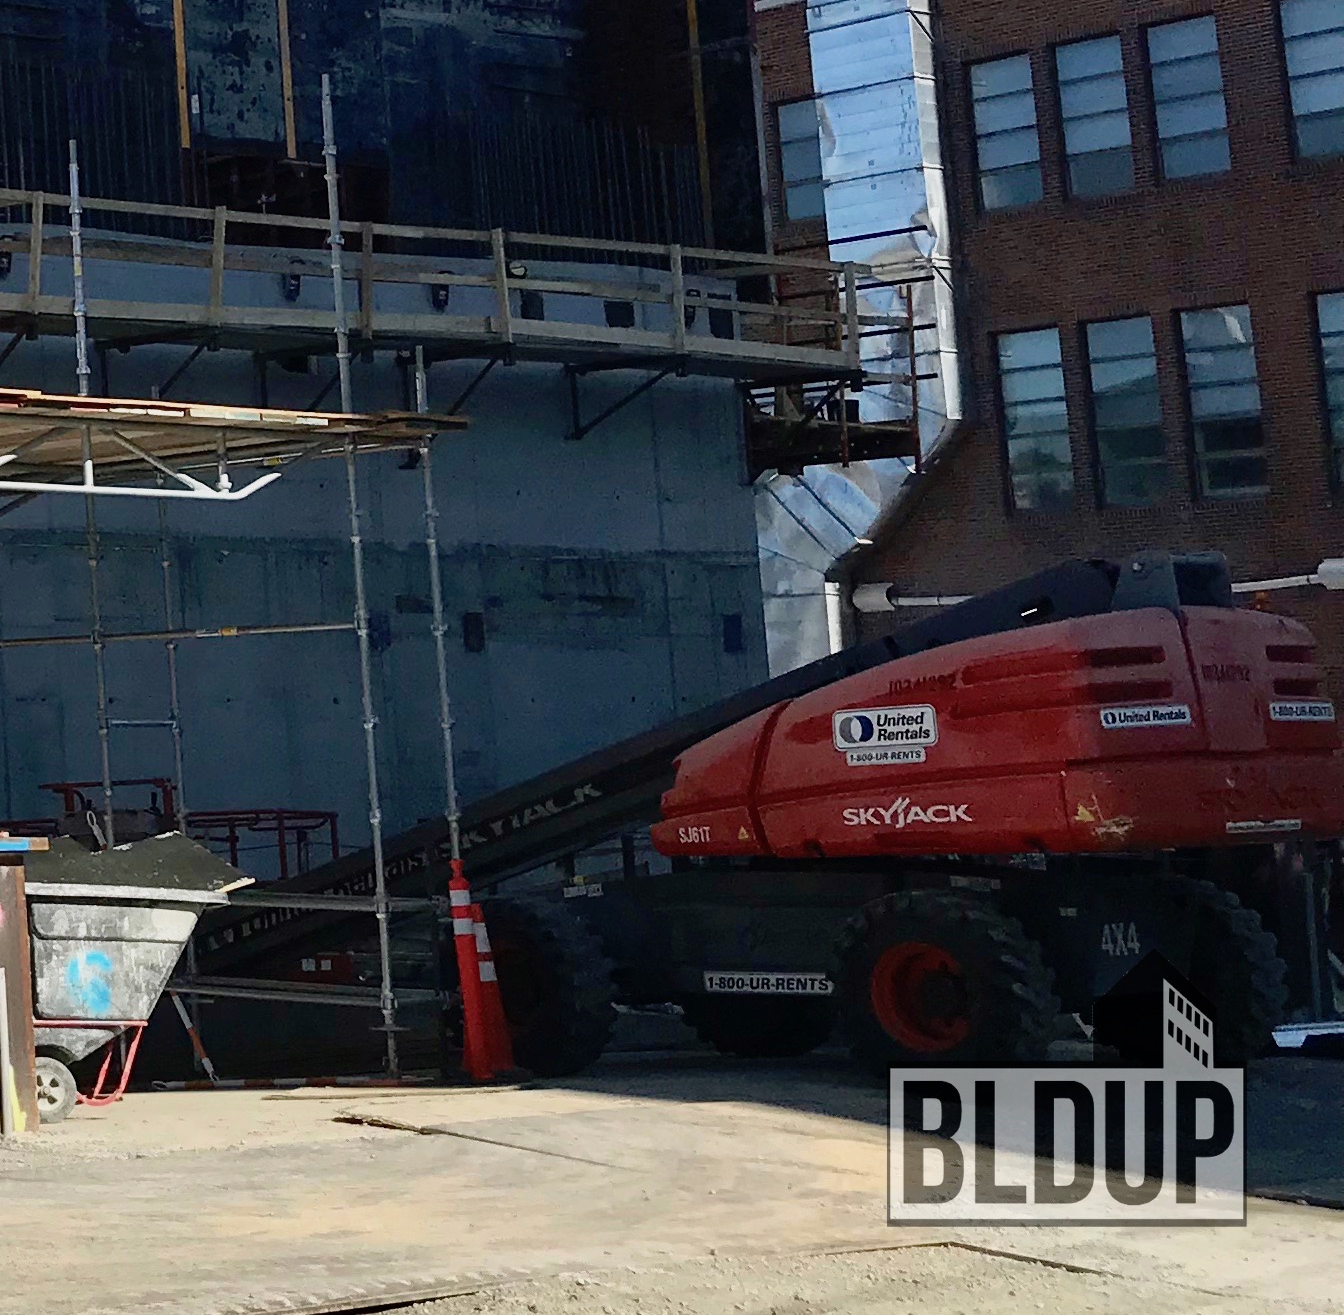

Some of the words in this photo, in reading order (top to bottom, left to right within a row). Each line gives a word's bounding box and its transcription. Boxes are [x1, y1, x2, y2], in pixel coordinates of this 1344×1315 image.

[877, 712, 925, 727] United
[1118, 711, 1150, 723] United
[1153, 709, 1187, 721] Rentals
[877, 726, 931, 741] Rentals
[850, 750, 922, 762] 1-800-UR-RENTS
[842, 796, 973, 828] SKYJACK
[707, 976, 829, 991] 1-800-UR-RENTS
